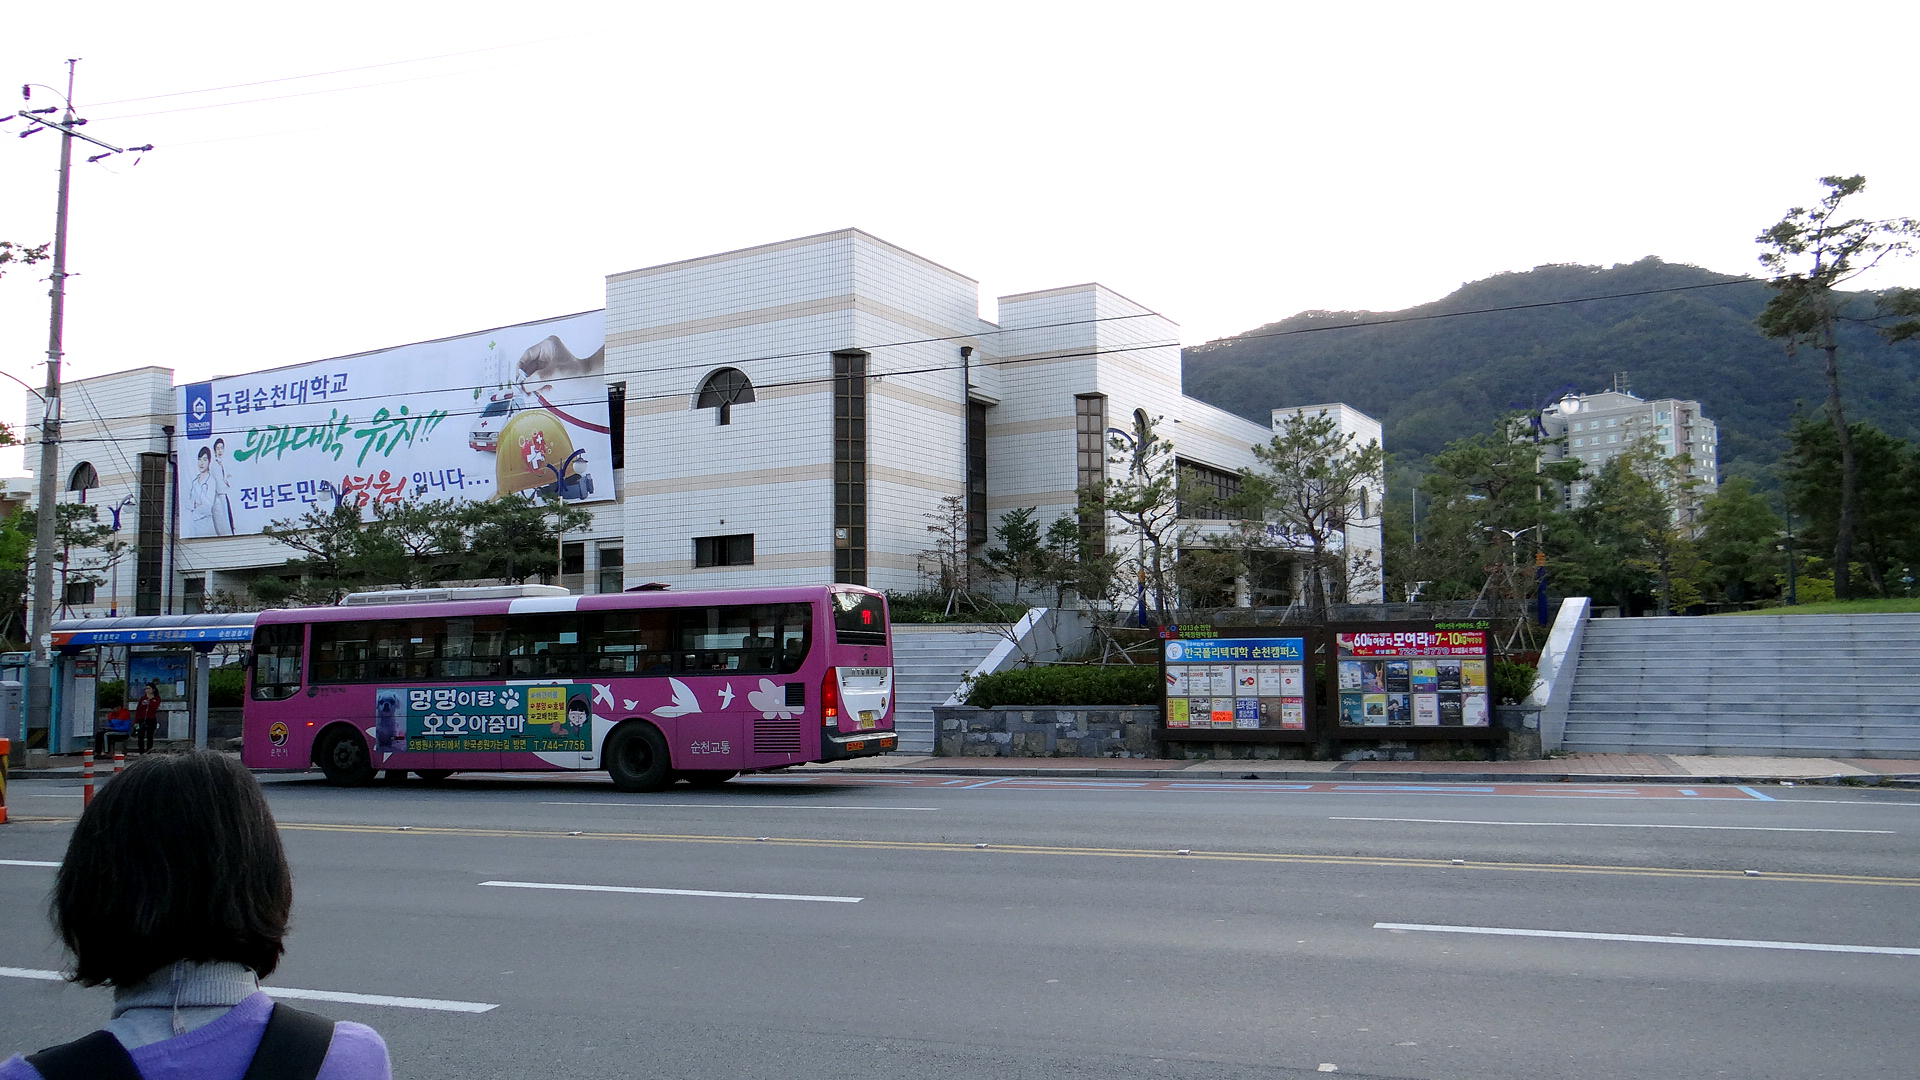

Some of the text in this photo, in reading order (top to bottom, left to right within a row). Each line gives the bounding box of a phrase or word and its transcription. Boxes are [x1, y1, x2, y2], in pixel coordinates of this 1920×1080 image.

[215, 373, 348, 416] 국립순천대학교
[233, 405, 448, 468] 의과대학 유치!!
[240, 479, 342, 510] 전남도민
[1373, 637, 1386, 647] 이상
[1386, 637, 1393, 646] 다
[1393, 632, 1435, 647] 모여라!!
[1184, 647, 1299, 659] 한국폴리텍대학 순천캠퍼스
[410, 689, 496, 711] 멍멍이랑
[536, 702, 547, 711] 분양
[512, 739, 527, 750] 방면
[534, 740, 585, 751] T.744-7756
[690, 740, 731, 754] 순천교통
[270, 748, 289, 757] 순천시
